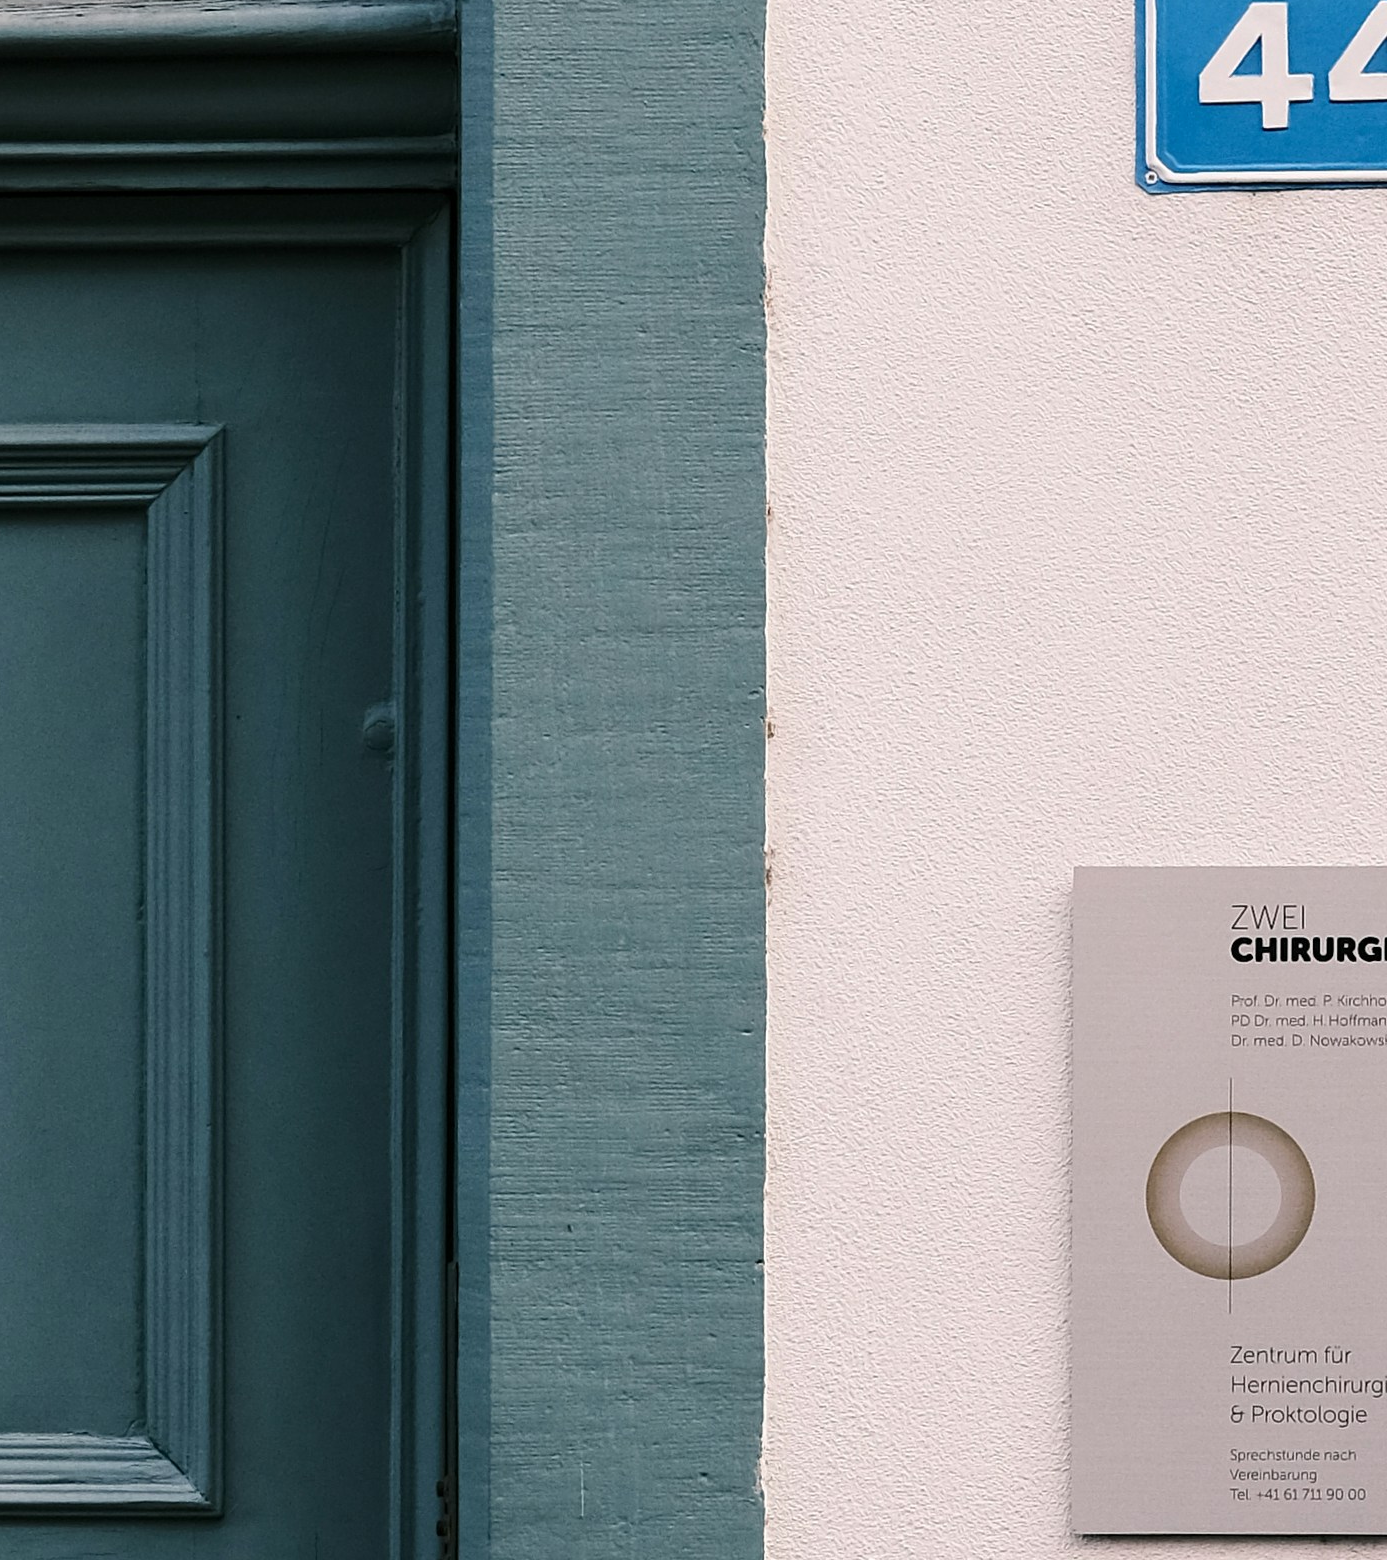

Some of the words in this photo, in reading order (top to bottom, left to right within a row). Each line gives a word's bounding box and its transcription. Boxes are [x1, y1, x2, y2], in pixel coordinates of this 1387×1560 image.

[1231, 904, 1305, 930] ZWEI
[1231, 994, 1260, 1008] Prof.
[1264, 994, 1281, 1008] Dr.
[1285, 994, 1318, 1008] med.
[1323, 994, 1333, 1008] P.
[1231, 1014, 1250, 1027] PD
[1255, 1014, 1271, 1027] Dr.
[1276, 1014, 1309, 1027] med.
[1313, 1014, 1325, 1027] H.
[1329, 1014, 1387, 1027] Hoffman
[1231, 1034, 1249, 1048] Dr.
[1253, 1034, 1287, 1048] med.
[1292, 1034, 1305, 1048] D.
[1230, 1345, 1317, 1364] Zentrum
[1325, 1345, 1352, 1364] für
[1230, 1405, 1245, 1424] &
[1252, 1405, 1368, 1428] Proktologie
[1230, 1448, 1320, 1463] Sprechstunde
[1324, 1448, 1357, 1461] nach
[1229, 1468, 1317, 1484] Vereinbarung
[1230, 1488, 1251, 1501] Tel.
[1256, 1488, 1279, 1501] +41
[1283, 1488, 1297, 1501] 61
[1302, 1488, 1322, 1501] 711
[1326, 1488, 1344, 1501] 90
[1348, 1488, 1366, 1501] 00
